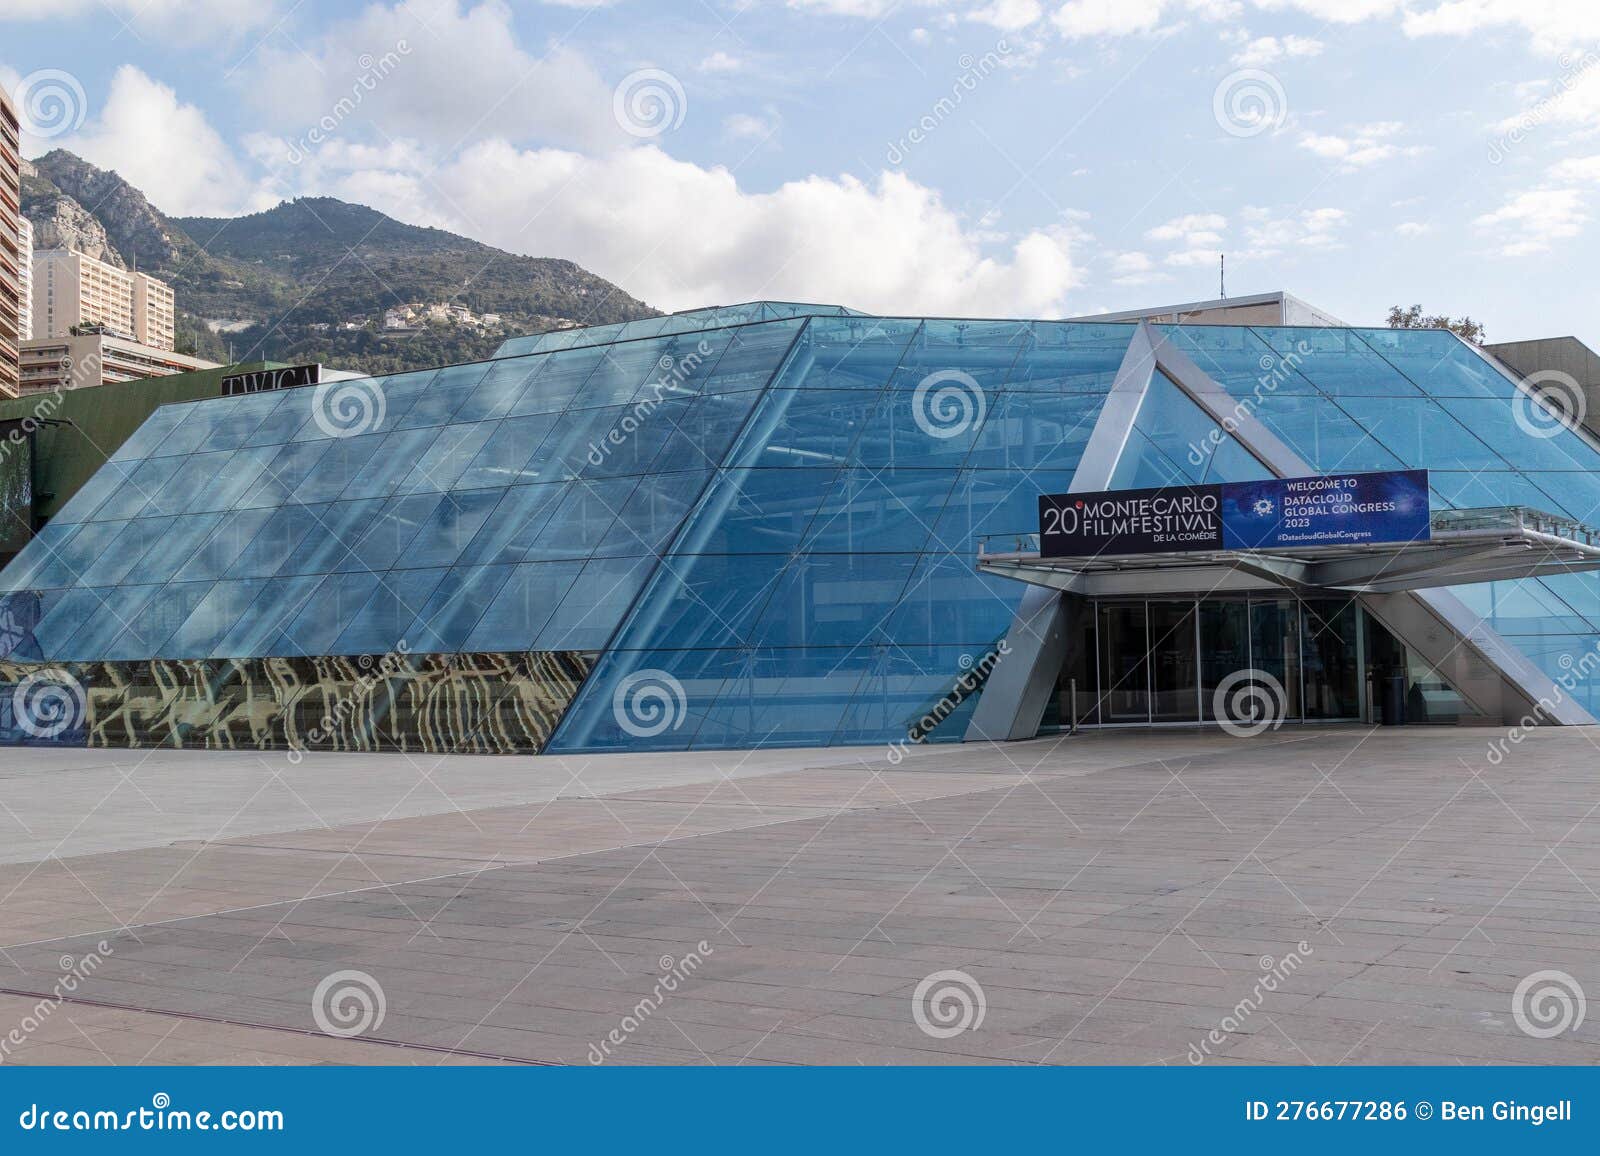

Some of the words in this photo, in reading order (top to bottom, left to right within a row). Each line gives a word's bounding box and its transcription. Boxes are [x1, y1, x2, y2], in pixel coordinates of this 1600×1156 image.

[1287, 480, 1341, 492] WELCOME
[1343, 478, 1357, 488] TO
[1284, 493, 1352, 506] DATACLOUD
[1284, 506, 1329, 517] GLOBAL
[1331, 501, 1396, 515] CONGRESS
[1083, 513, 1217, 537] FILMFESTIVAL
[1285, 518, 1310, 528] 2023
[1153, 534, 1164, 542] DE
[1278, 530, 1372, 542] #DatacloudGlobalCongress
